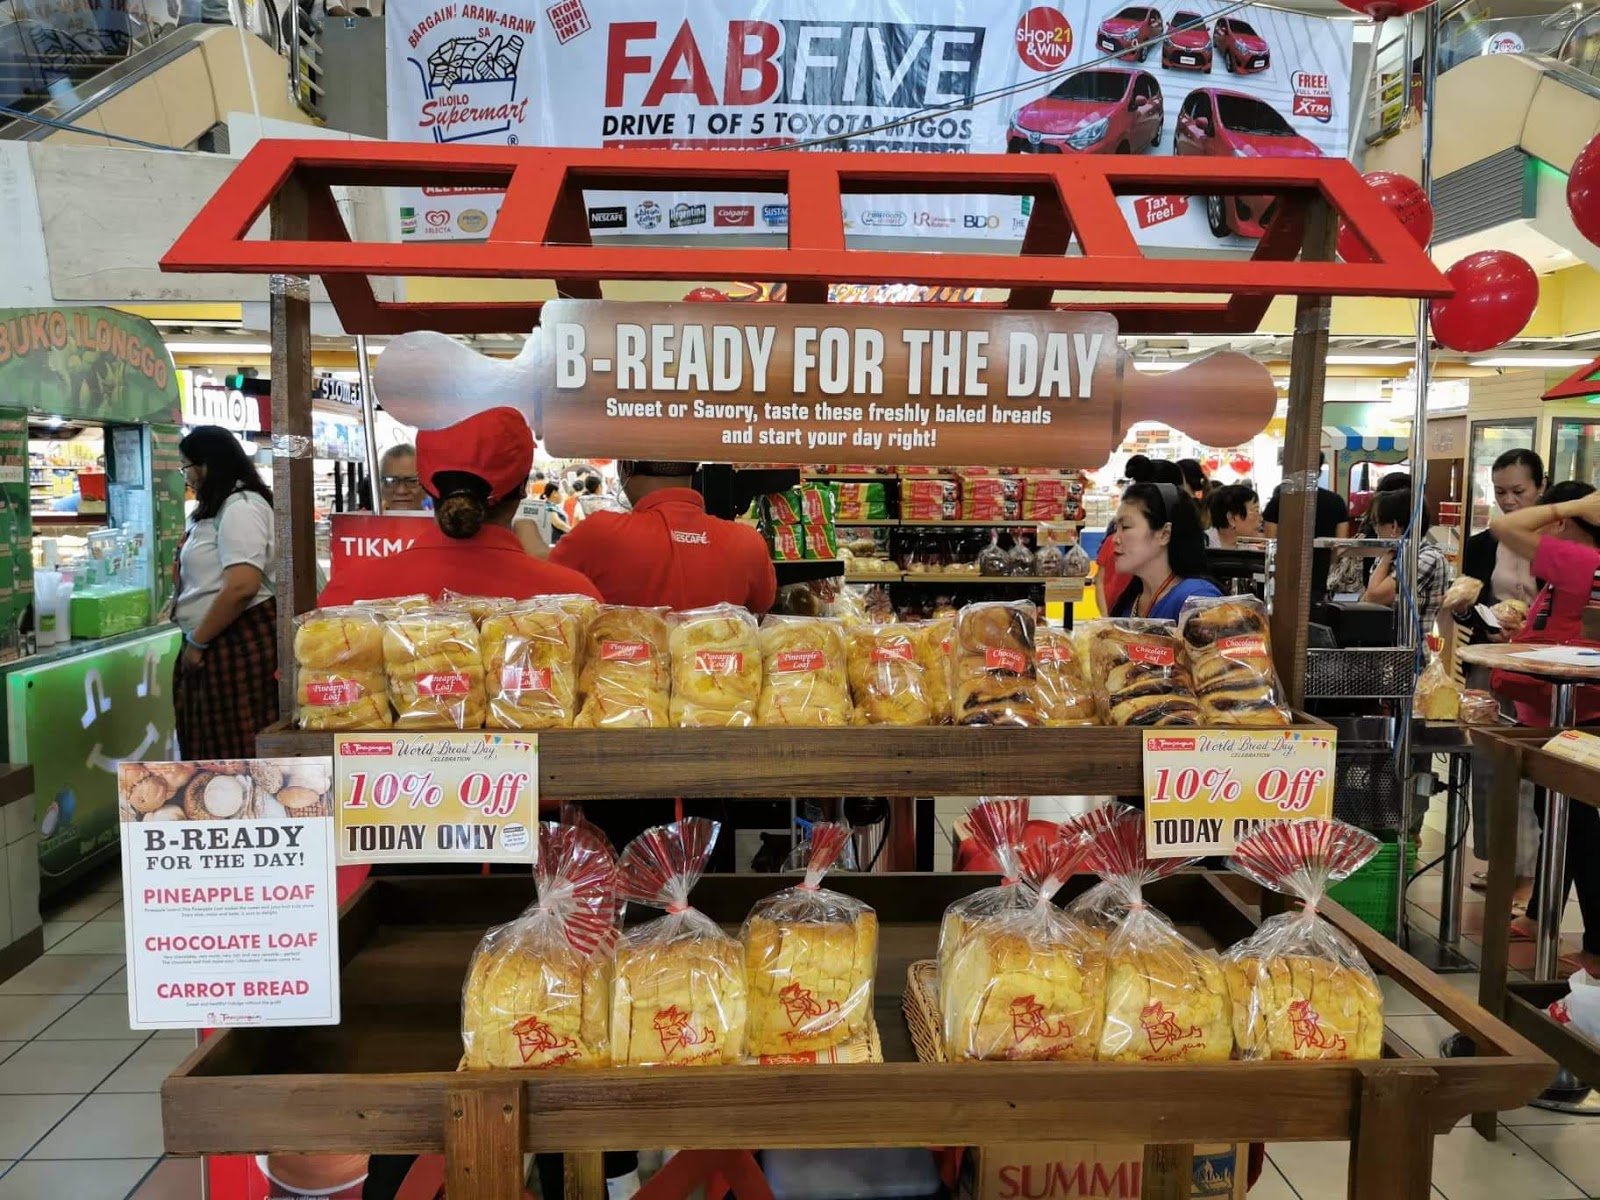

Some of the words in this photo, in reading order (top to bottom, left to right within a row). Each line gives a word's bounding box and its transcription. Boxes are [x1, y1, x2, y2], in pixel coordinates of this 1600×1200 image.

[408, 3, 457, 48] BARGAIN!
[462, 4, 536, 34] ARAW-ARAW
[555, 9, 582, 29] GUID
[478, 27, 491, 38] SA
[1298, 74, 1327, 88] FREE!
[439, 94, 469, 107] ILOILO
[418, 97, 529, 131] Supermart
[602, 113, 675, 136] DRIVE
[687, 113, 696, 135] 1
[707, 113, 743, 135] OF
[750, 113, 765, 135] 5
[776, 112, 872, 136] TOYOTA
[883, 116, 973, 140] WIGOS
[718, 208, 749, 218] Colgate
[1145, 196, 1168, 210] Tax
[964, 215, 999, 228] BDO
[1146, 206, 1174, 223] free!
[0, 311, 66, 365] BUKO
[73, 312, 168, 390] ILONGGO
[555, 322, 776, 394] B-READY
[793, 326, 885, 395] FOR
[902, 329, 989, 398] THE
[1006, 331, 1104, 399] DAY
[606, 398, 662, 418] Sweet
[668, 403, 687, 418] or
[693, 400, 758, 422] Savory,
[764, 403, 809, 421] taste
[815, 404, 863, 422] these
[869, 404, 930, 426] freshly
[935, 405, 987, 425] baked
[992, 405, 1052, 426] breads
[721, 426, 753, 445] and
[758, 428, 802, 446] start
[807, 431, 847, 450] your
[852, 429, 882, 450] day
[888, 429, 937, 450] right!
[784, 653, 817, 662] Pineapple
[314, 683, 350, 693] Pineapple
[396, 736, 433, 757] World
[437, 738, 468, 755] Bread
[472, 738, 498, 759] Day
[1199, 732, 1235, 752] World
[1238, 736, 1268, 751] Bread
[1272, 736, 1296, 756] Day
[346, 772, 442, 808] 10%
[460, 773, 529, 815] Off
[1152, 767, 1239, 801] 10%
[1257, 768, 1325, 810] Off
[144, 825, 304, 851] B-READY
[346, 824, 426, 851] TODAY
[437, 824, 497, 850] ONLY
[1153, 818, 1224, 844] TODAY
[146, 855, 192, 870] FOR
[200, 854, 244, 868] THE
[254, 852, 305, 867] DAY!
[144, 886, 254, 904] PINEAPPLE
[262, 884, 315, 901] LOAF
[145, 935, 260, 952] CHOCOLATE
[269, 932, 318, 948] LOAF
[157, 982, 236, 999] CARROT
[244, 980, 310, 996] BREAD
